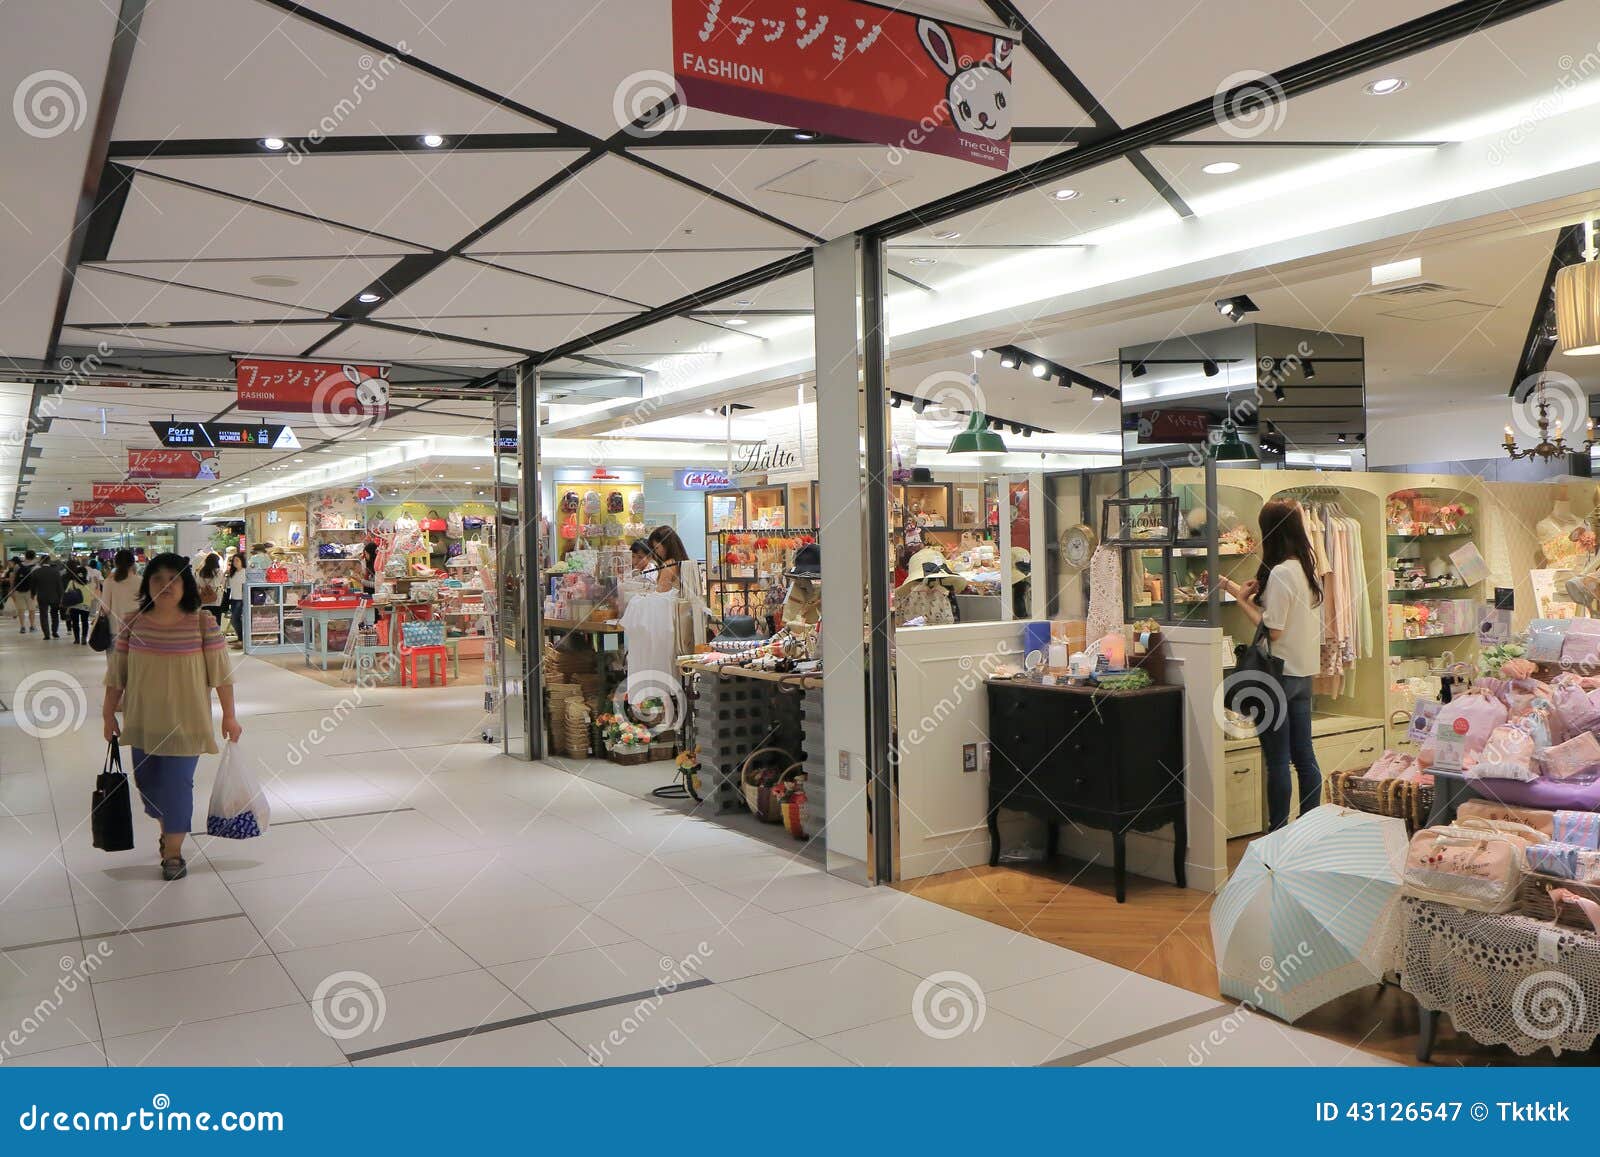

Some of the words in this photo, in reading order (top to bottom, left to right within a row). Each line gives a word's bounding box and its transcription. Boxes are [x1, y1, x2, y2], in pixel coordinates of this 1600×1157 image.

[682, 52, 764, 85] FASHION
[241, 365, 327, 387] ファッション
[240, 391, 275, 400] FASHION
[168, 427, 195, 436] Porta
[734, 440, 796, 473] Aälto
